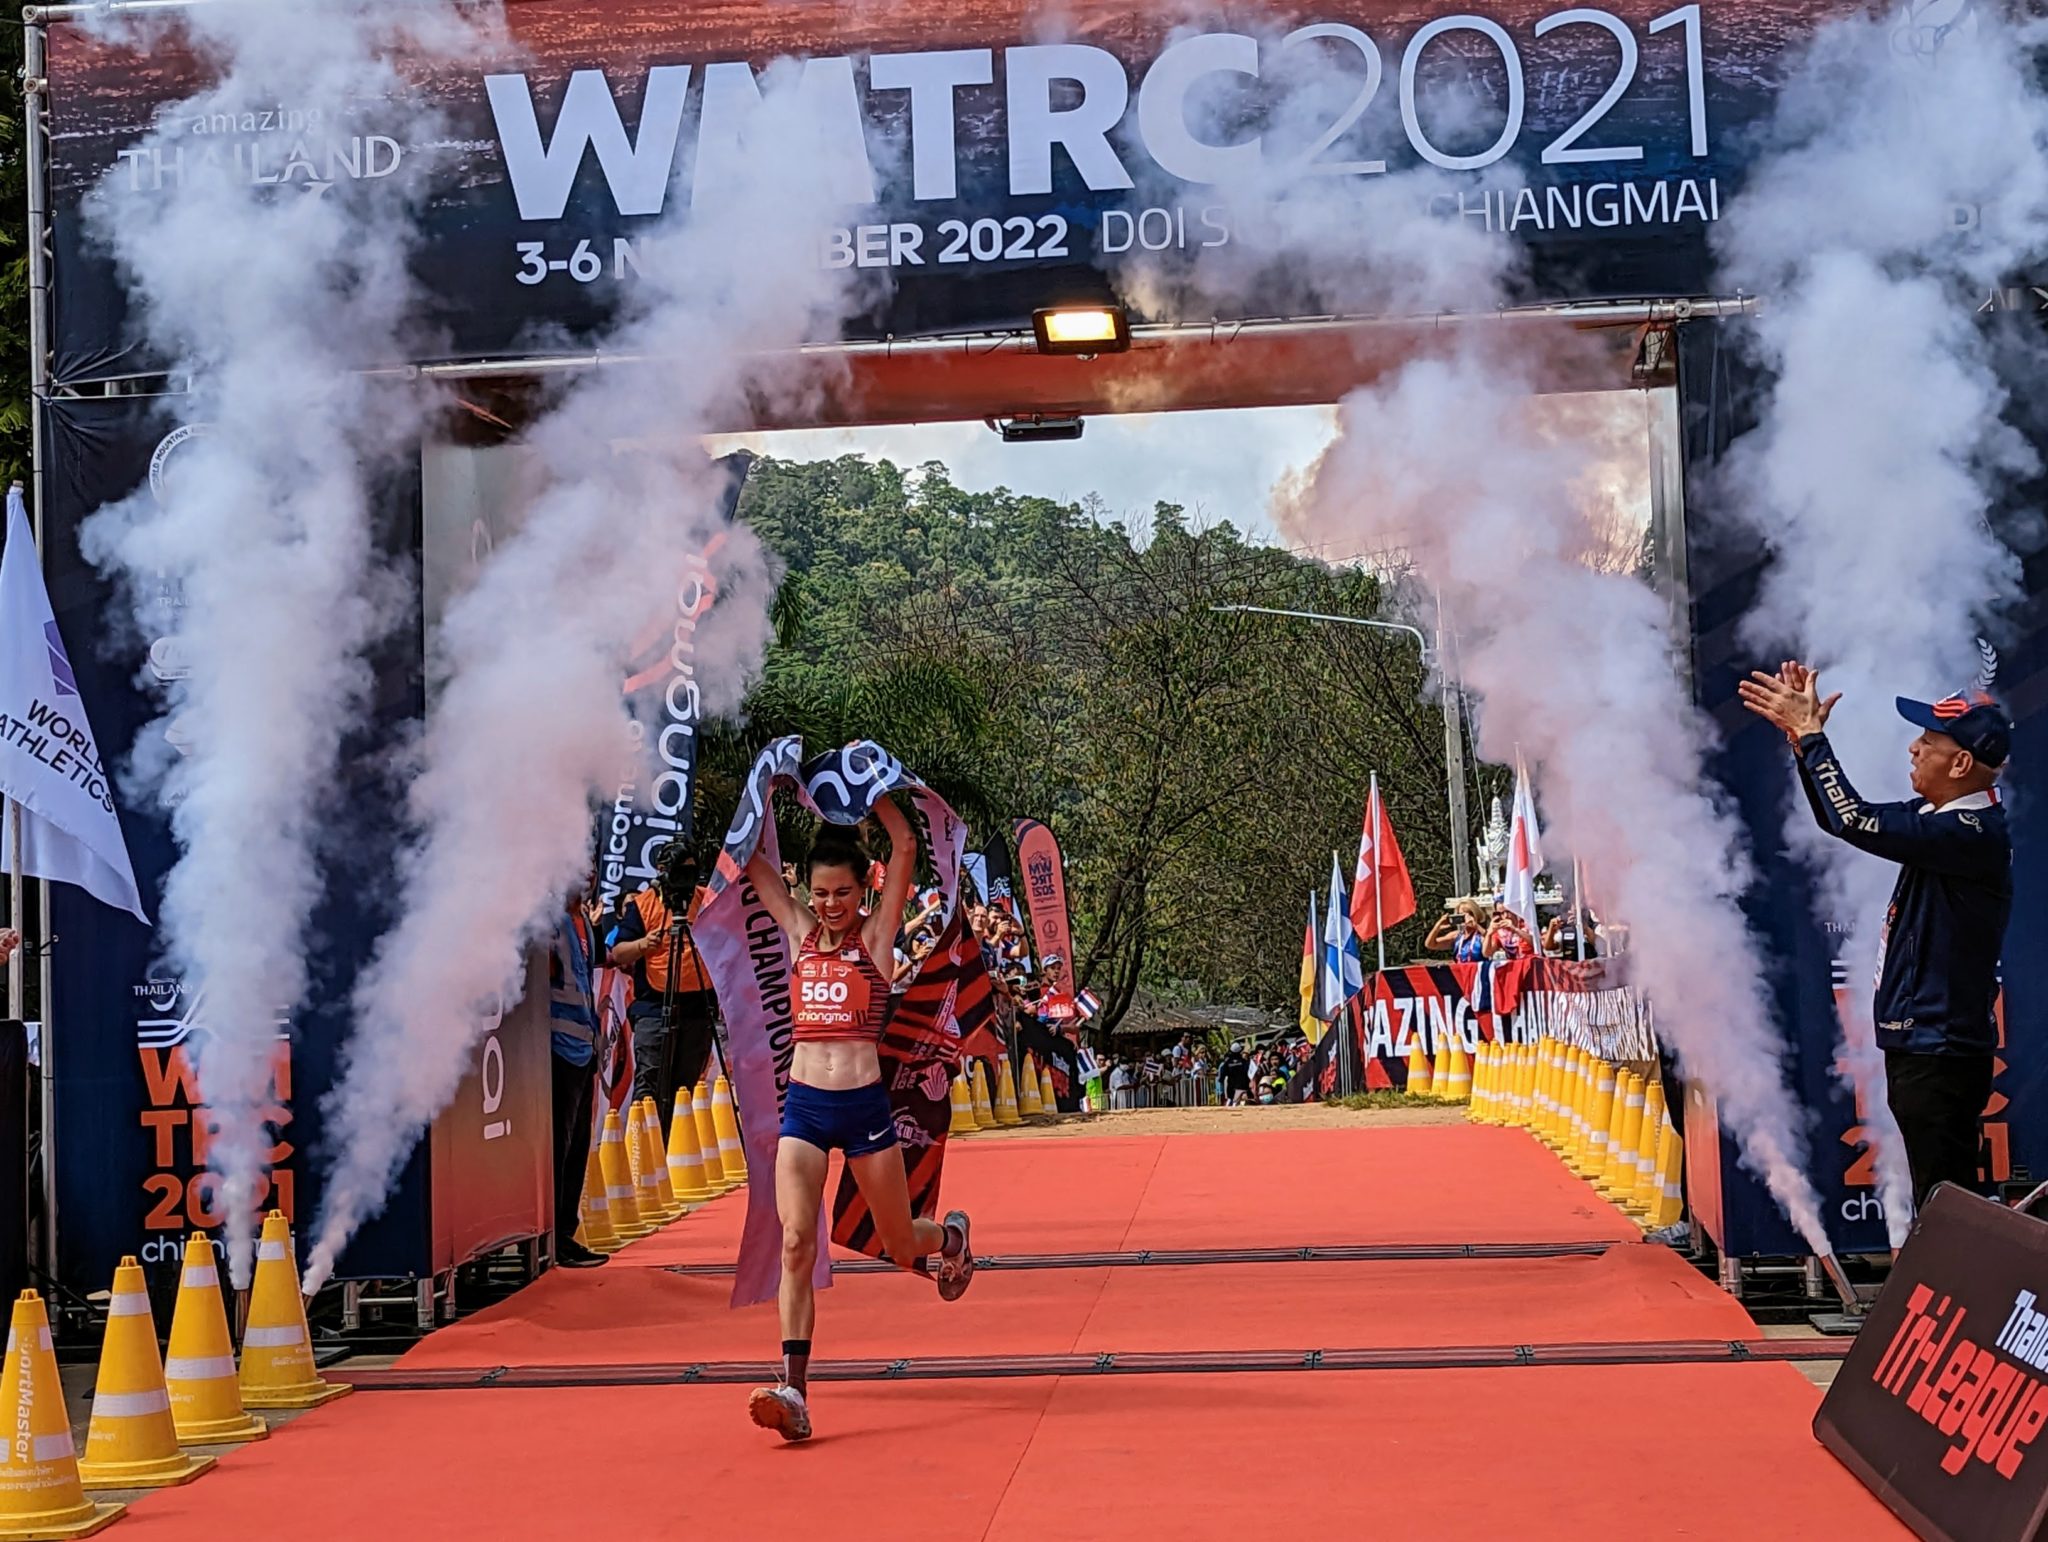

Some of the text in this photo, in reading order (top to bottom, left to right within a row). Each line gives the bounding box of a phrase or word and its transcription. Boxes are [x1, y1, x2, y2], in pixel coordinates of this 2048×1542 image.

[192, 104, 322, 136] amazing
[515, 239, 601, 285] 3-6
[938, 214, 1069, 264] 2022
[1102, 206, 1186, 253] DOI
[615, 553, 708, 893] hiangmai
[801, 981, 848, 1003] 560
[1872, 1283, 2048, 1480] Tri-League
